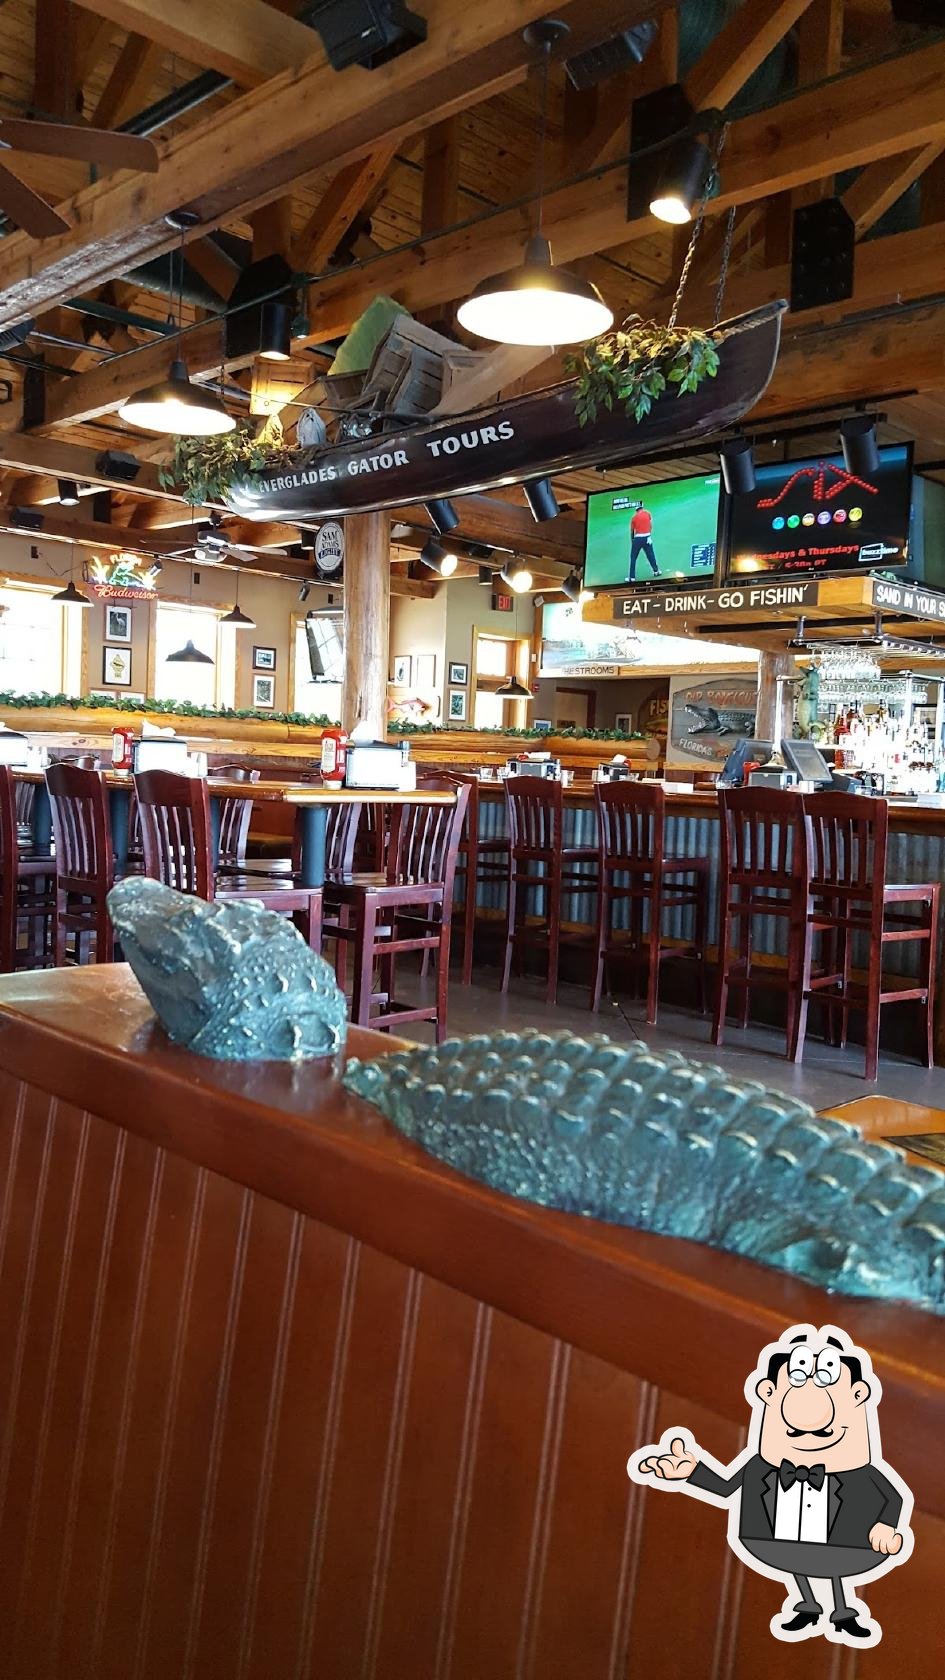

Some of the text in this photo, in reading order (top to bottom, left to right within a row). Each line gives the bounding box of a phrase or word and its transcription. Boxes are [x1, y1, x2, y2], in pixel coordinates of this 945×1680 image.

[258, 420, 514, 494] EVERGLADES GATOR TOURS
[322, 530, 339, 541] SAM
[808, 544, 860, 557] Thursdays
[94, 584, 159, 600] Budweiser
[623, 599, 651, 615] EAT
[665, 595, 707, 612] DRINK
[718, 592, 744, 608] GO
[750, 584, 809, 606] FISHIN'
[876, 584, 901, 606] SAND
[903, 592, 914, 609] IN
[915, 595, 937, 615] YOUR
